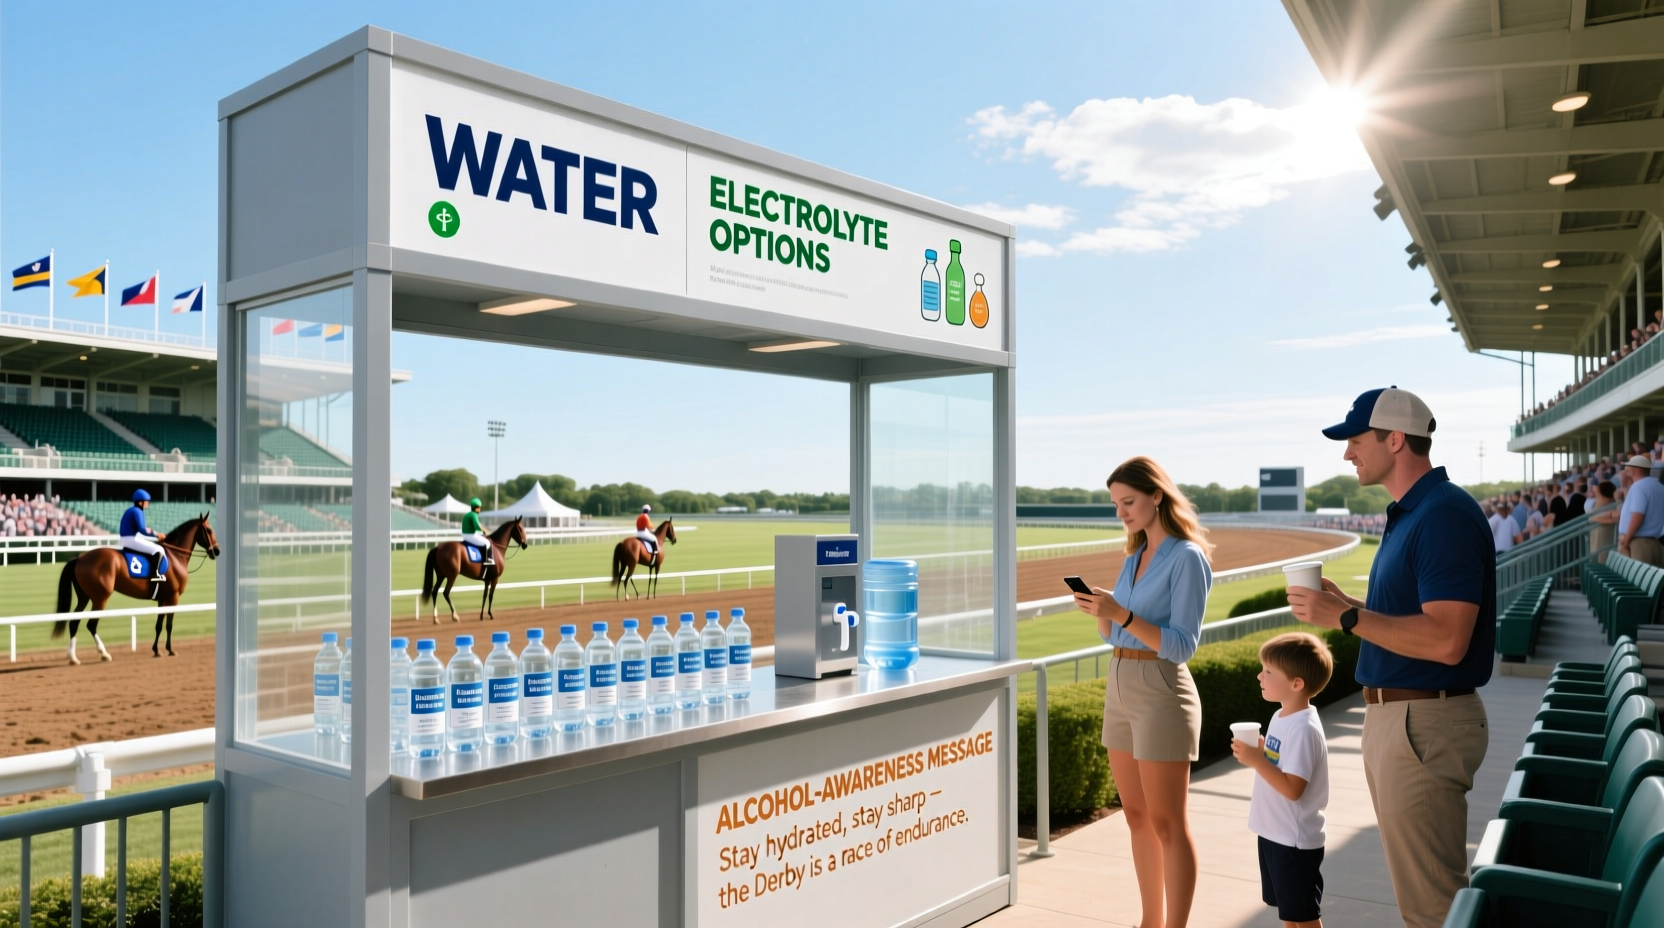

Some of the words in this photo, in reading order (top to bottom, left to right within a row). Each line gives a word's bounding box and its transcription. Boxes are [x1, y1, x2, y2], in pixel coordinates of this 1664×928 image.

[425, 114, 659, 235] WATER
[710, 175, 889, 250] ELECTROLYTE
[709, 219, 831, 273] OPTIONS
[716, 751, 924, 834] ALCOHOL-AWARENESS
[928, 731, 993, 770] MESSAGE
[719, 843, 760, 872] Stay
[766, 811, 847, 861] hydrated,
[852, 805, 883, 829] stay
[887, 792, 926, 814] sharp
[719, 882, 749, 909] the
[755, 862, 805, 897] Derby
[810, 855, 822, 877] is
[828, 854, 836, 871] a
[841, 842, 873, 866] race
[877, 829, 892, 853] of
[896, 807, 969, 846] endurance.
